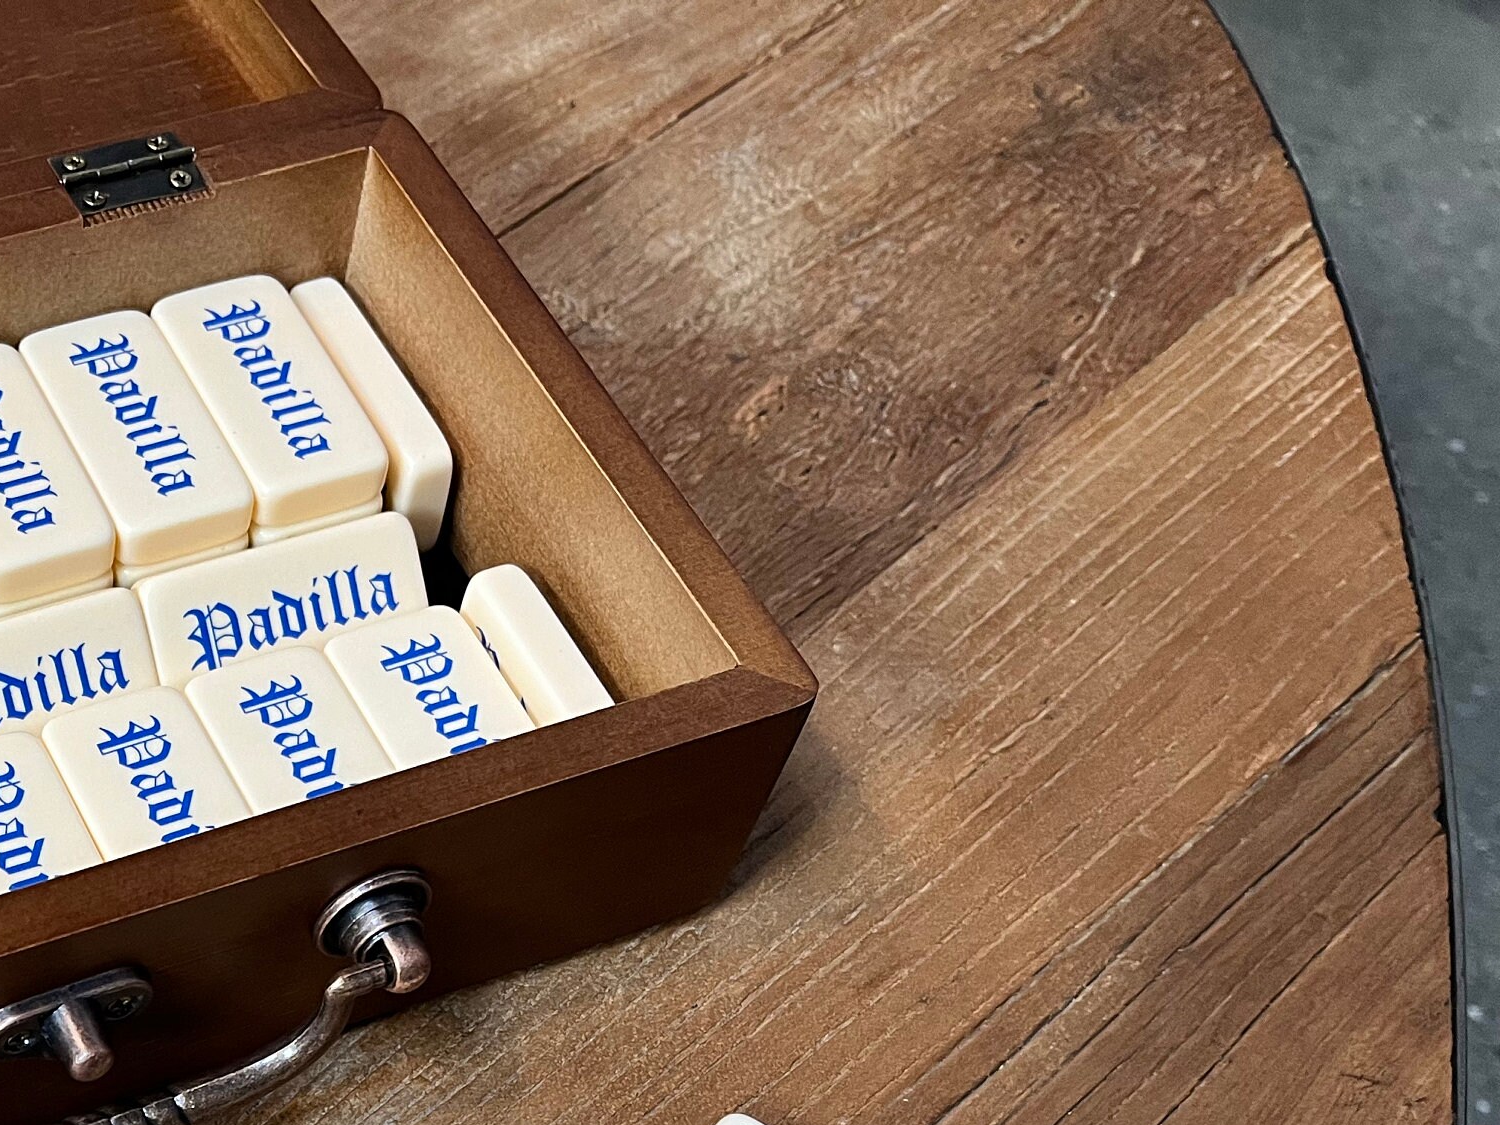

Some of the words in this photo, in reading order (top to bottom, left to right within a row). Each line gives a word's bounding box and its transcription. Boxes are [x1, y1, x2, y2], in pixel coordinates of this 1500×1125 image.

[69, 335, 195, 496] Padilla
[203, 301, 331, 459] Padilla
[183, 565, 400, 671] Padilla
